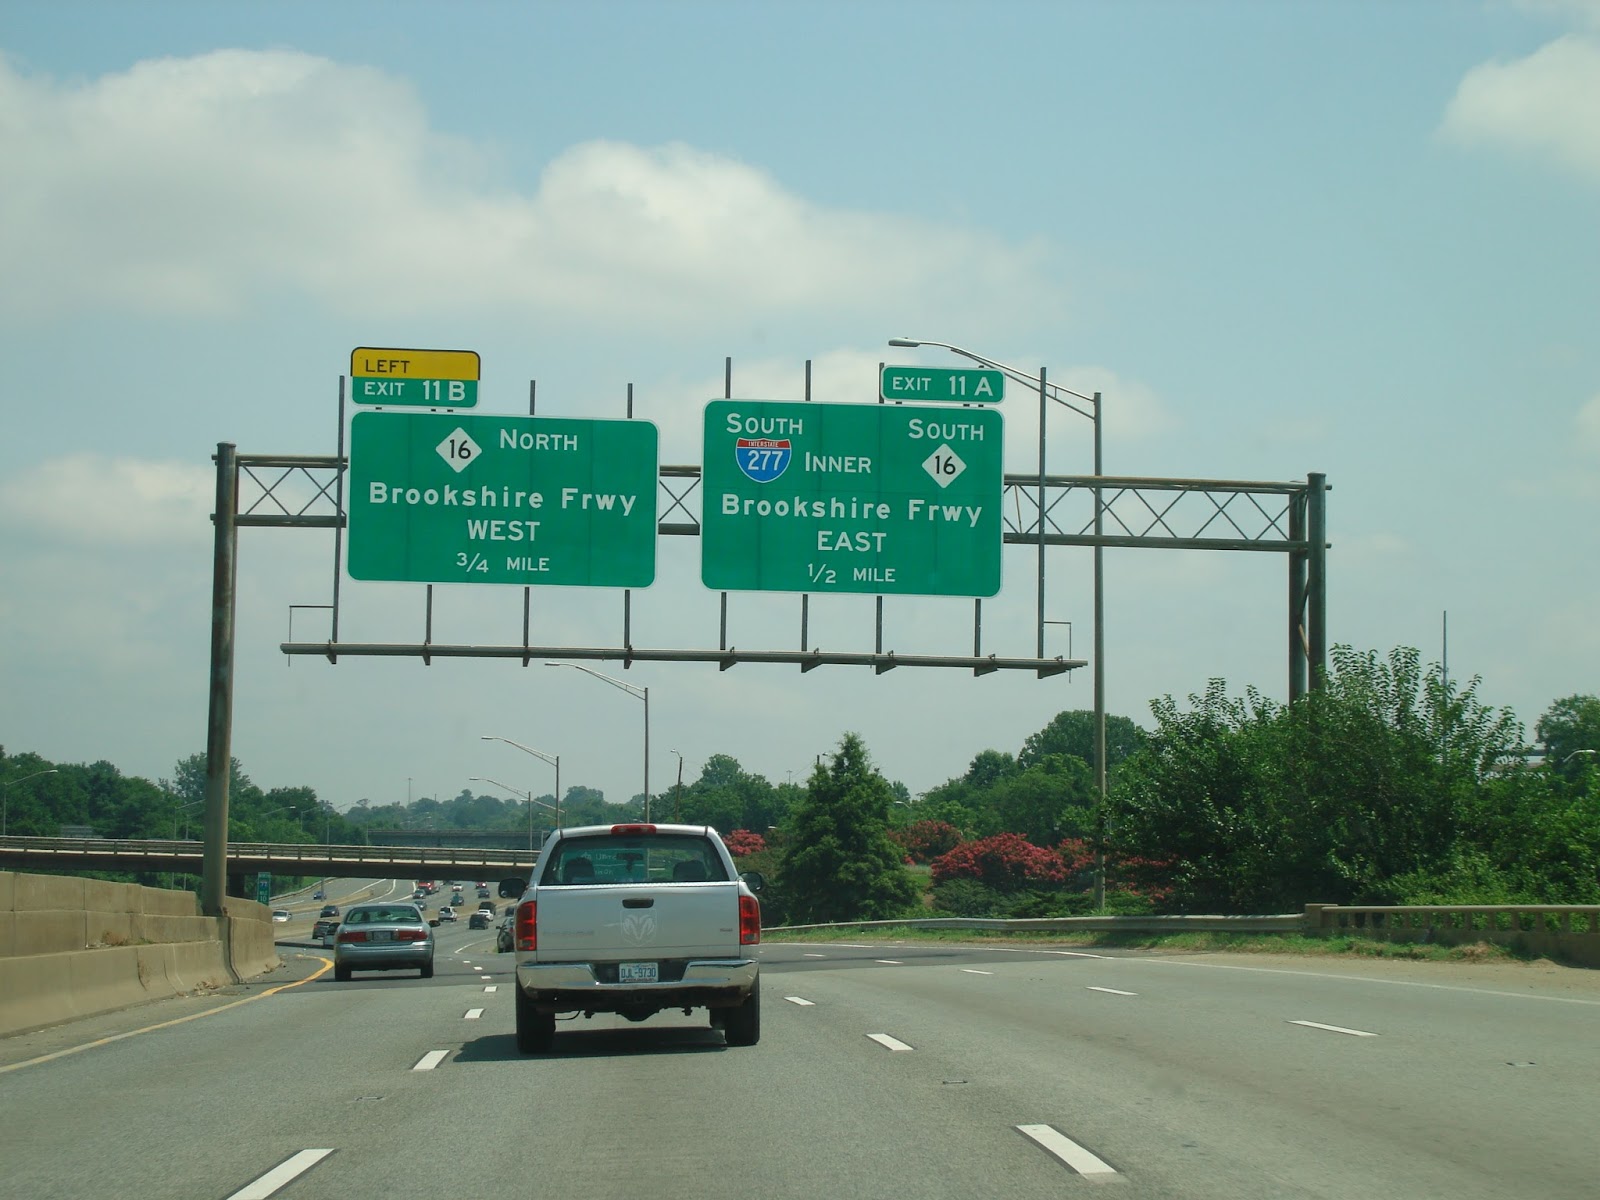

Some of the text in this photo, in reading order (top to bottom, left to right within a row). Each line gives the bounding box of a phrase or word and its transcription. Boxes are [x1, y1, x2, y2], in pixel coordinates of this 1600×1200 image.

[365, 359, 411, 374] LEFT
[364, 380, 466, 401] EXIT 11 B
[892, 376, 994, 397] EXIT 11 A
[449, 439, 471, 460] 16
[748, 440, 779, 448] INTERSTATE
[747, 449, 783, 471] 277
[934, 455, 956, 475] 16
[369, 481, 637, 517] Brookshire Frwy
[722, 493, 982, 528] Brookshire Frwy
[467, 519, 541, 542] WEST
[817, 530, 887, 553] EAST
[456, 552, 550, 573] 3/4 MILE
[807, 563, 896, 584] 1/2 MILE
